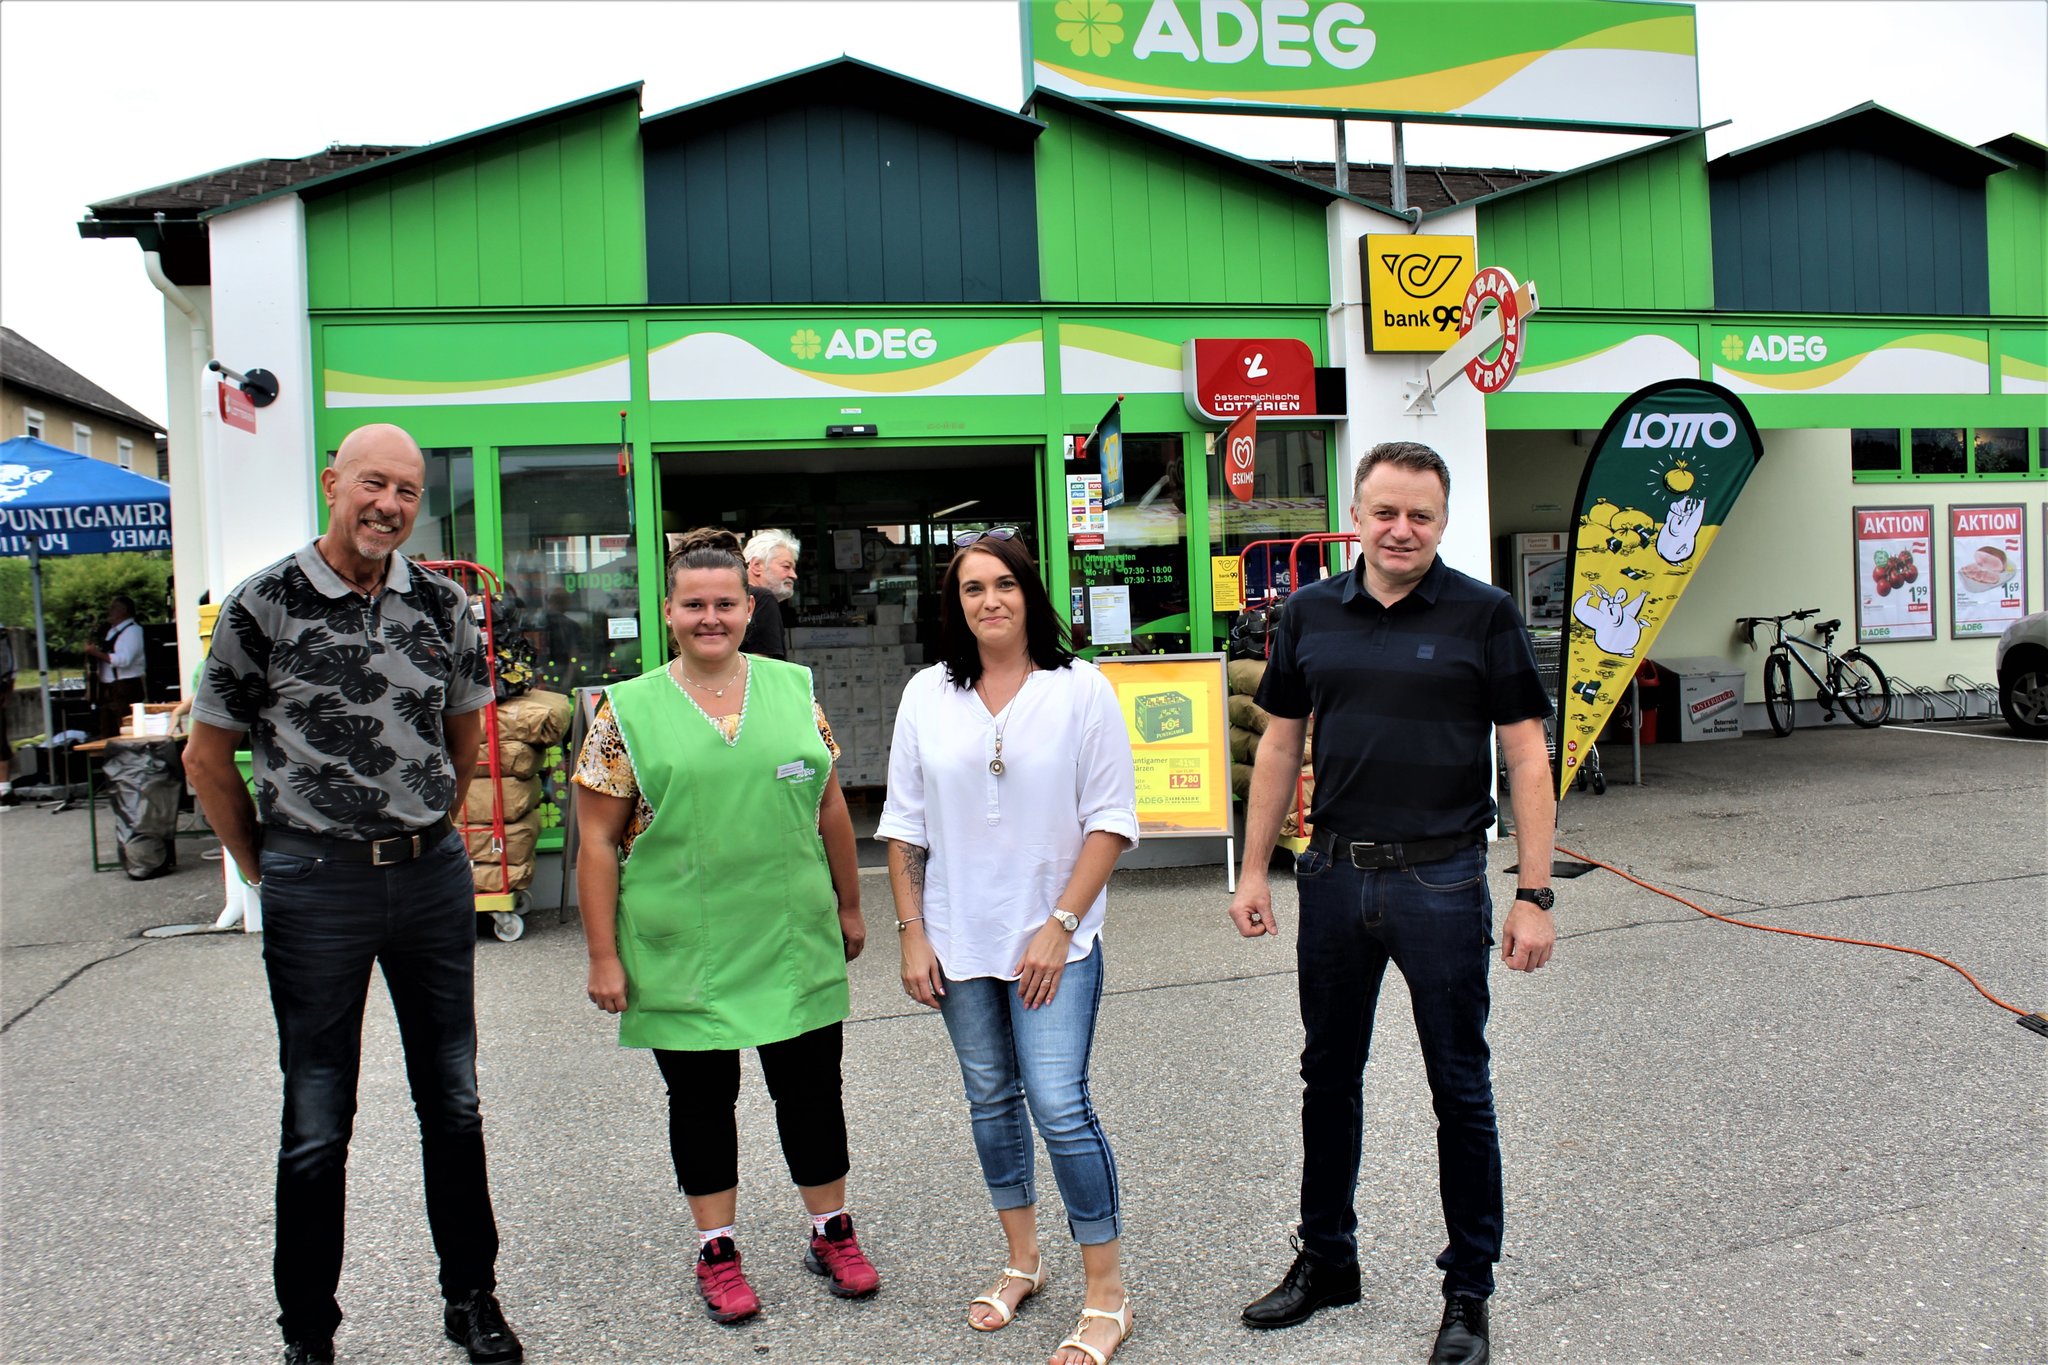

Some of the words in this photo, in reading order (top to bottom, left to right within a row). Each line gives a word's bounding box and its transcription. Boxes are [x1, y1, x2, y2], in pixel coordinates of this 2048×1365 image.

[1132, 0, 1377, 70] ADEG
[1461, 273, 1509, 329] TABAK
[1384, 309, 1431, 327] bank
[1432, 305, 1463, 332] 99
[824, 328, 937, 360] ADEG
[1473, 314, 1516, 388] TRAFIK
[1745, 335, 1828, 362] ADEG
[1214, 392, 1300, 401] österreichische
[1214, 401, 1300, 412] LOTTERIEN
[1621, 412, 1737, 449] LOTTO
[1232, 471, 1254, 485] ESKIMO
[1863, 515, 1925, 534] AKTION
[1957, 513, 2017, 531] AKTION
[1085, 569, 1097, 577] Mo
[1123, 567, 1145, 575] 07:30
[1151, 566, 1173, 574] 18:00
[1085, 578, 1095, 586] Sa
[1124, 576, 1146, 584] 07:30
[1152, 575, 1173, 583] 12:30
[1868, 627, 1891, 637] ADEG
[1961, 622, 1983, 631] ADEG
[1133, 757, 1168, 765] untigamer
[1138, 796, 1164, 804] ADEG
